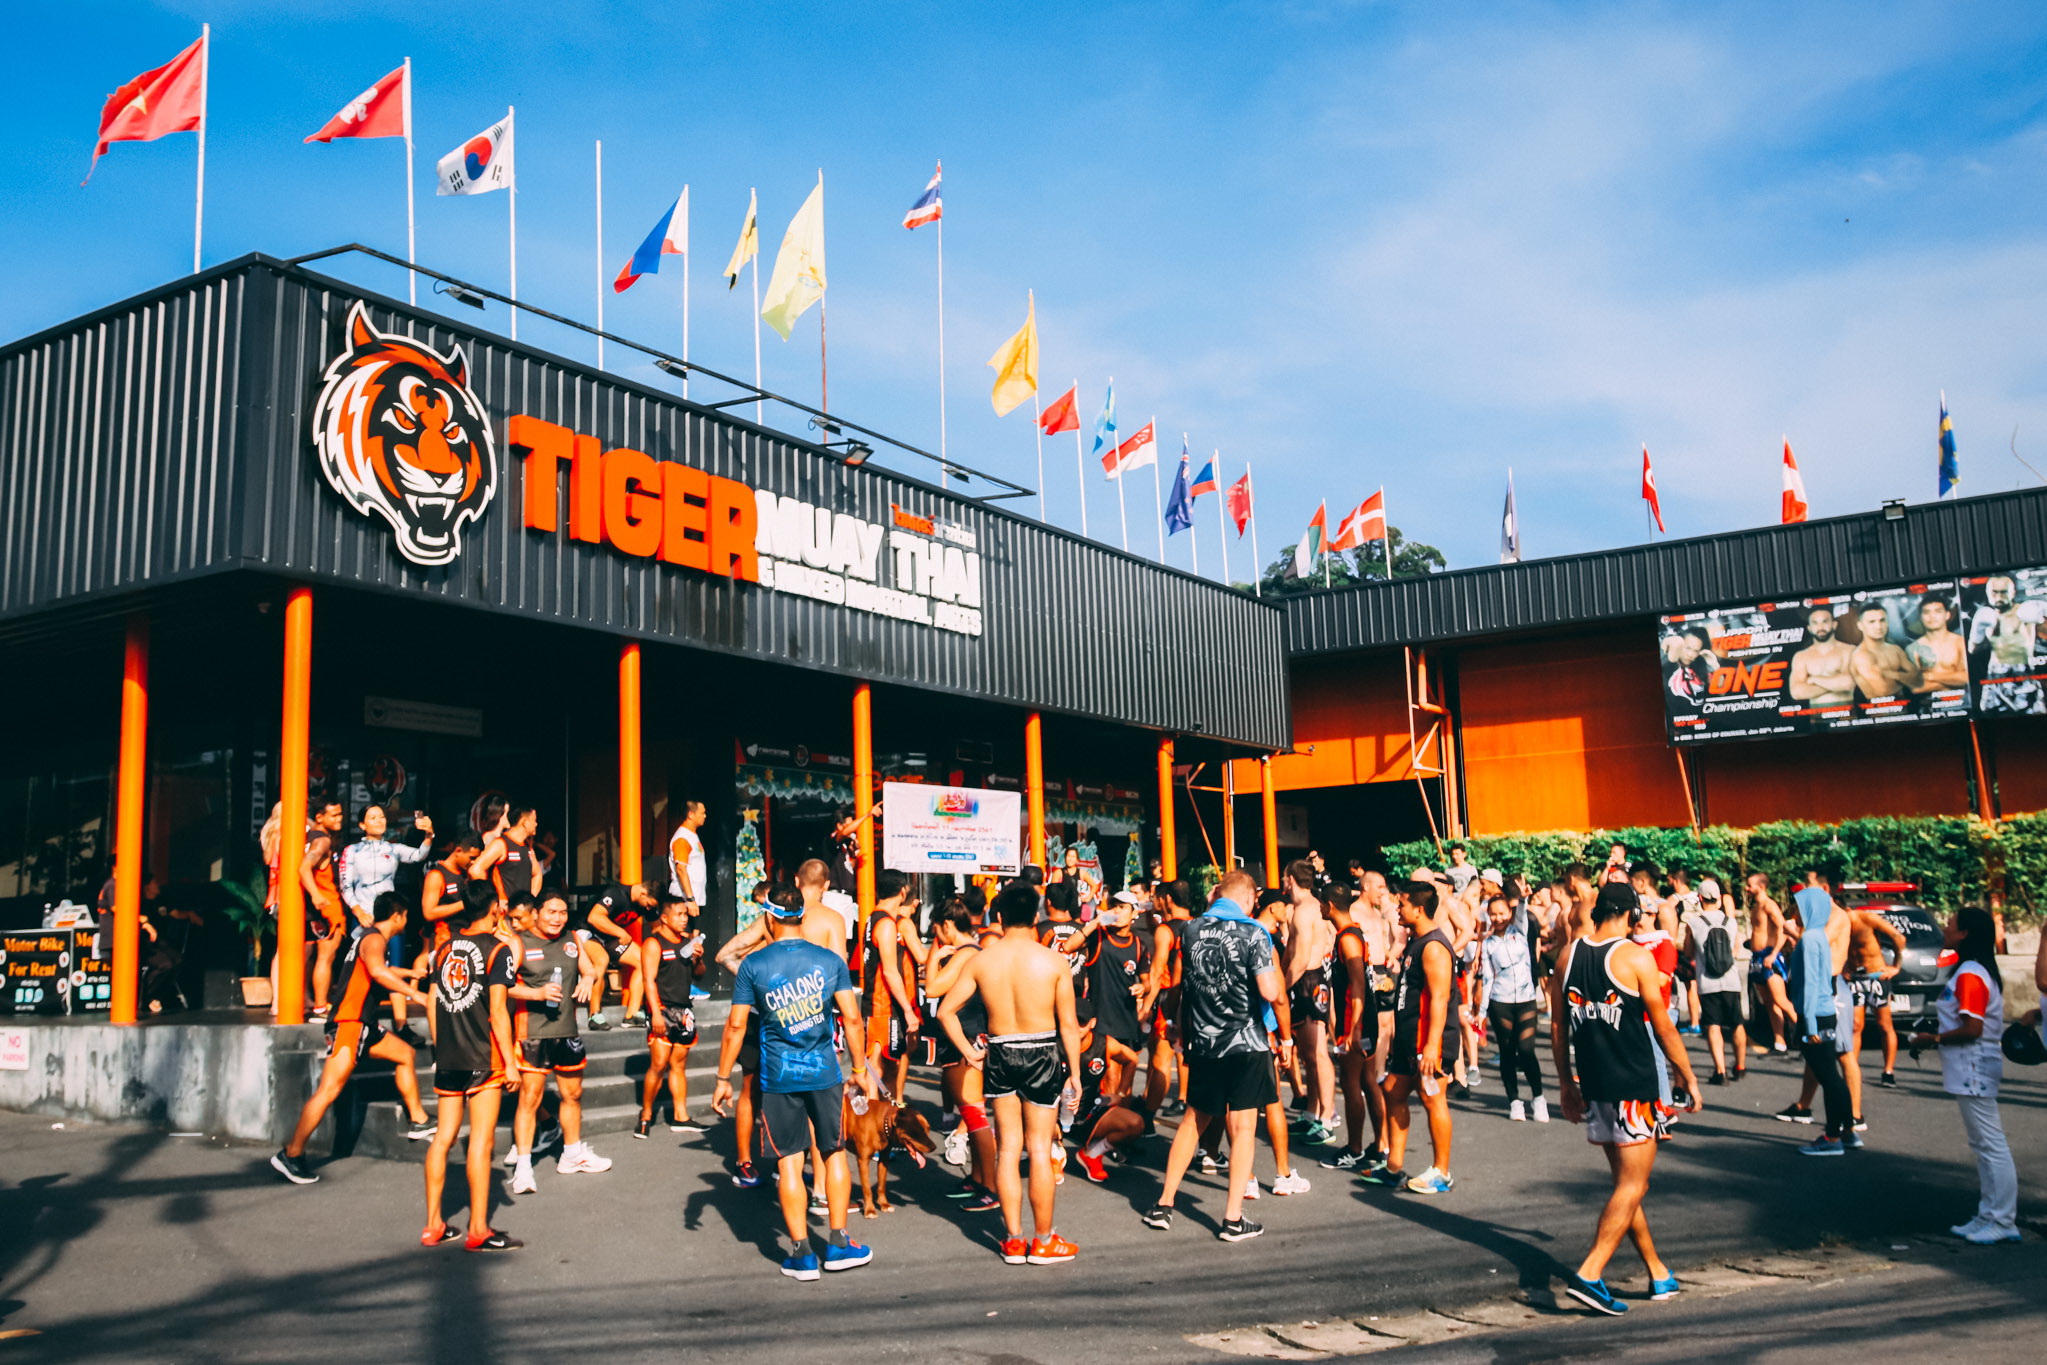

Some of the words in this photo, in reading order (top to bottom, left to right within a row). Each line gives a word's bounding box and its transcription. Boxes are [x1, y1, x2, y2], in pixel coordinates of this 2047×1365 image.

[509, 414, 759, 583] TIGER
[754, 488, 884, 582] MUAY
[889, 530, 982, 608] THAI
[774, 560, 845, 605] MIXED
[844, 577, 933, 626] MARTIAL
[934, 601, 982, 637] ARTS
[1711, 634, 1752, 651] TIGER
[1708, 660, 1789, 696] ONE
[1702, 698, 1778, 714] Championship
[1199, 929, 1228, 940] MUAY
[4, 937, 38, 952] Motor
[39, 936, 66, 952] Bike
[8, 961, 29, 977] For
[30, 960, 57, 977] Rent
[81, 957, 101, 972] For
[765, 969, 825, 1010] CHALONG
[777, 991, 824, 1028] PHUKET
[9, 1035, 21, 1048] NO
